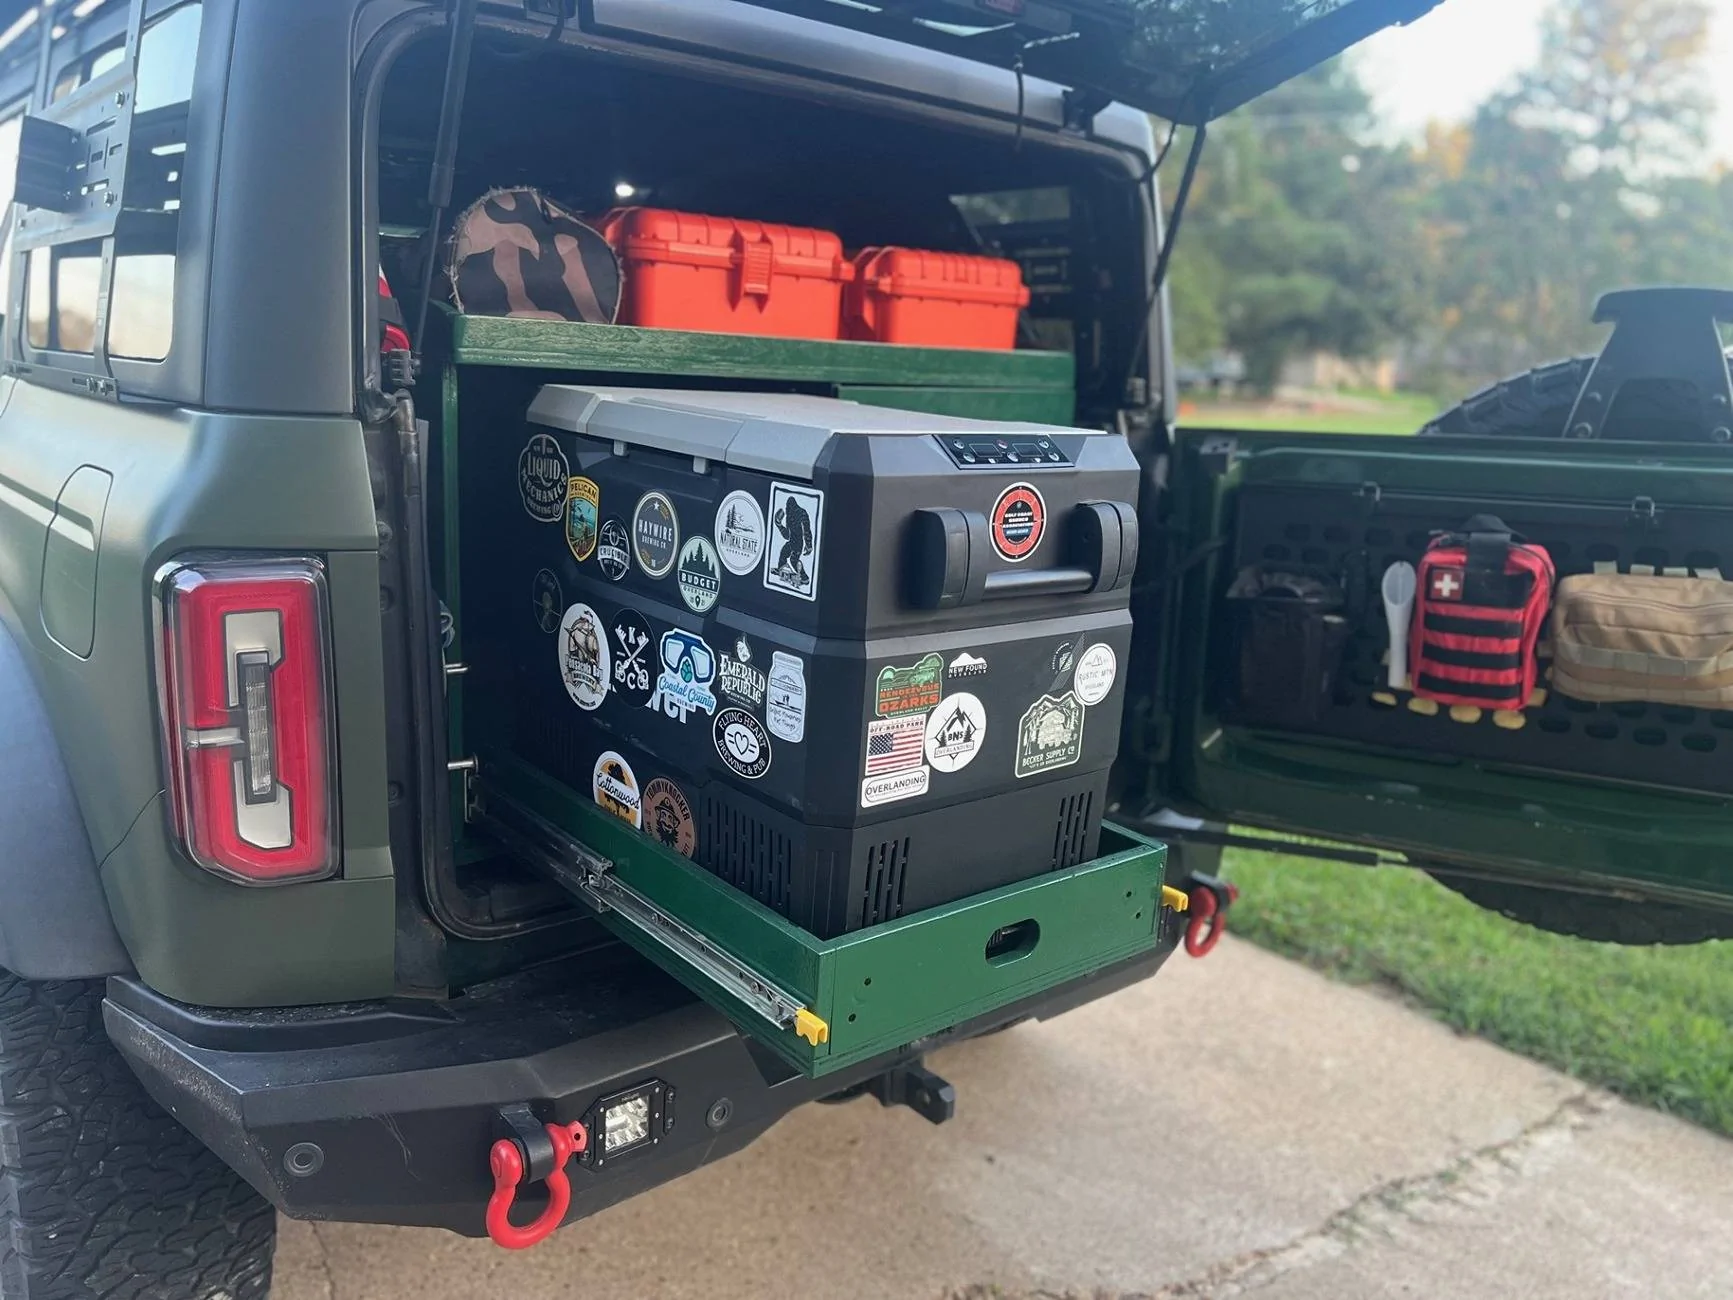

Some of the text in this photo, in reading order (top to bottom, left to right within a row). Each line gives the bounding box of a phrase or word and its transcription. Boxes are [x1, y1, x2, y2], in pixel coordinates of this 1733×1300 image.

[527, 452, 561, 487] LIQUID
[571, 482, 597, 500] PELICAN
[639, 520, 673, 542] HAYWIRE
[641, 535, 660, 548] BREWING
[720, 532, 758, 553] NATURAL STATE
[600, 547, 628, 564] CRUCIBLE
[681, 572, 716, 590] BUDGET
[683, 585, 713, 599] OVERLAND
[719, 654, 766, 692] EMERALD
[948, 663, 988, 674] NEW FOUND
[659, 676, 688, 697] Coastal
[687, 688, 716, 712] County
[721, 676, 762, 704] REPUBLIC
[880, 683, 940, 698] RENDEZVOUS
[879, 694, 939, 713] OZARKS
[719, 712, 743, 730] FLYING
[870, 723, 905, 733] OFF-ROAD
[906, 720, 925, 728] PARK
[743, 715, 767, 748] HEART
[717, 739, 766, 775] BREWING & PUB
[935, 742, 974, 756] OVERLANDING
[1022, 754, 1043, 767] BECKER
[1046, 748, 1066, 760] SUPPLY
[597, 773, 640, 810] Cottonwood
[866, 775, 926, 796] OVERLANDING
[646, 780, 690, 821] TOMMYKNOCKER
